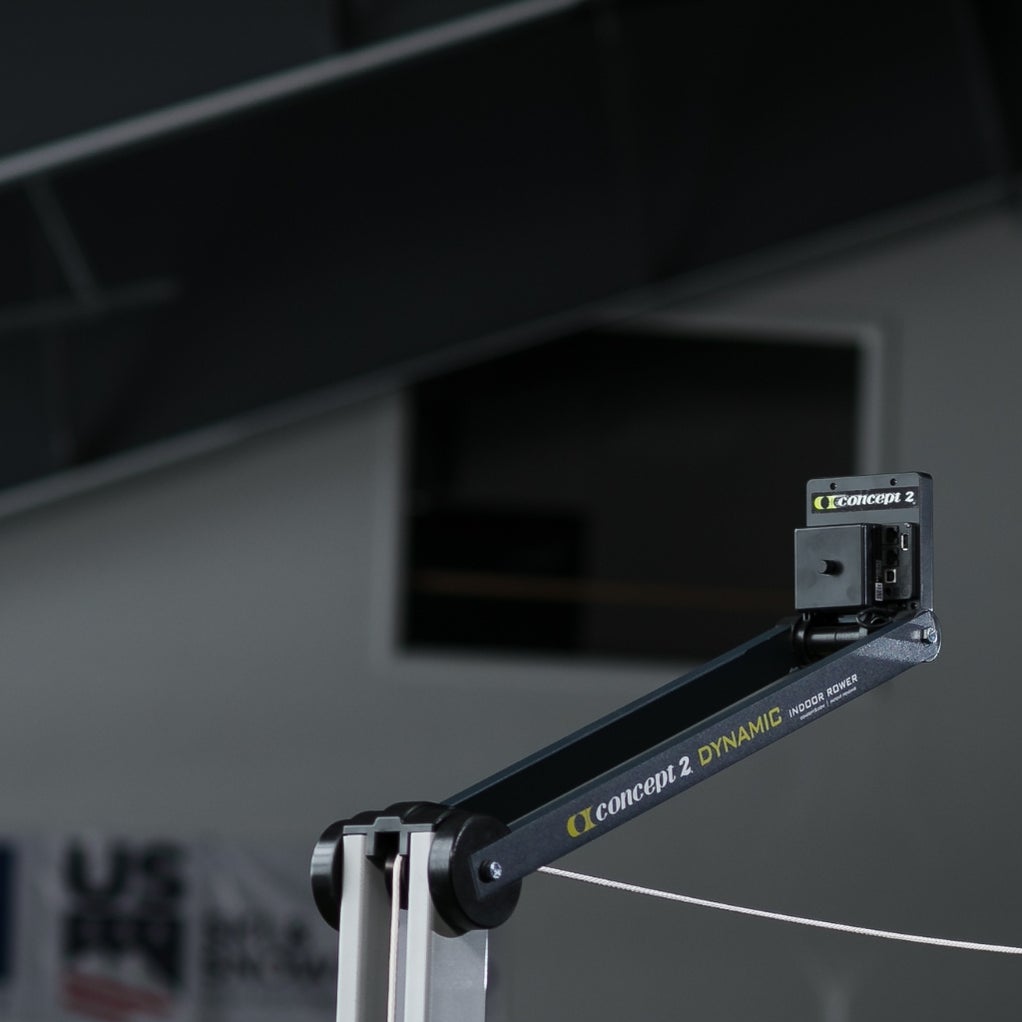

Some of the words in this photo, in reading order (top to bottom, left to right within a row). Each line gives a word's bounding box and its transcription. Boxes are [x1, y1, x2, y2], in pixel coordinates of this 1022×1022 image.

[837, 491, 902, 507] concept
[904, 491, 915, 503] 2
[788, 692, 825, 718] INDOOR
[826, 673, 858, 697] ROWER
[595, 764, 676, 822] concept
[678, 755, 692, 777] 2
[697, 706, 783, 767] DYNAMIC
